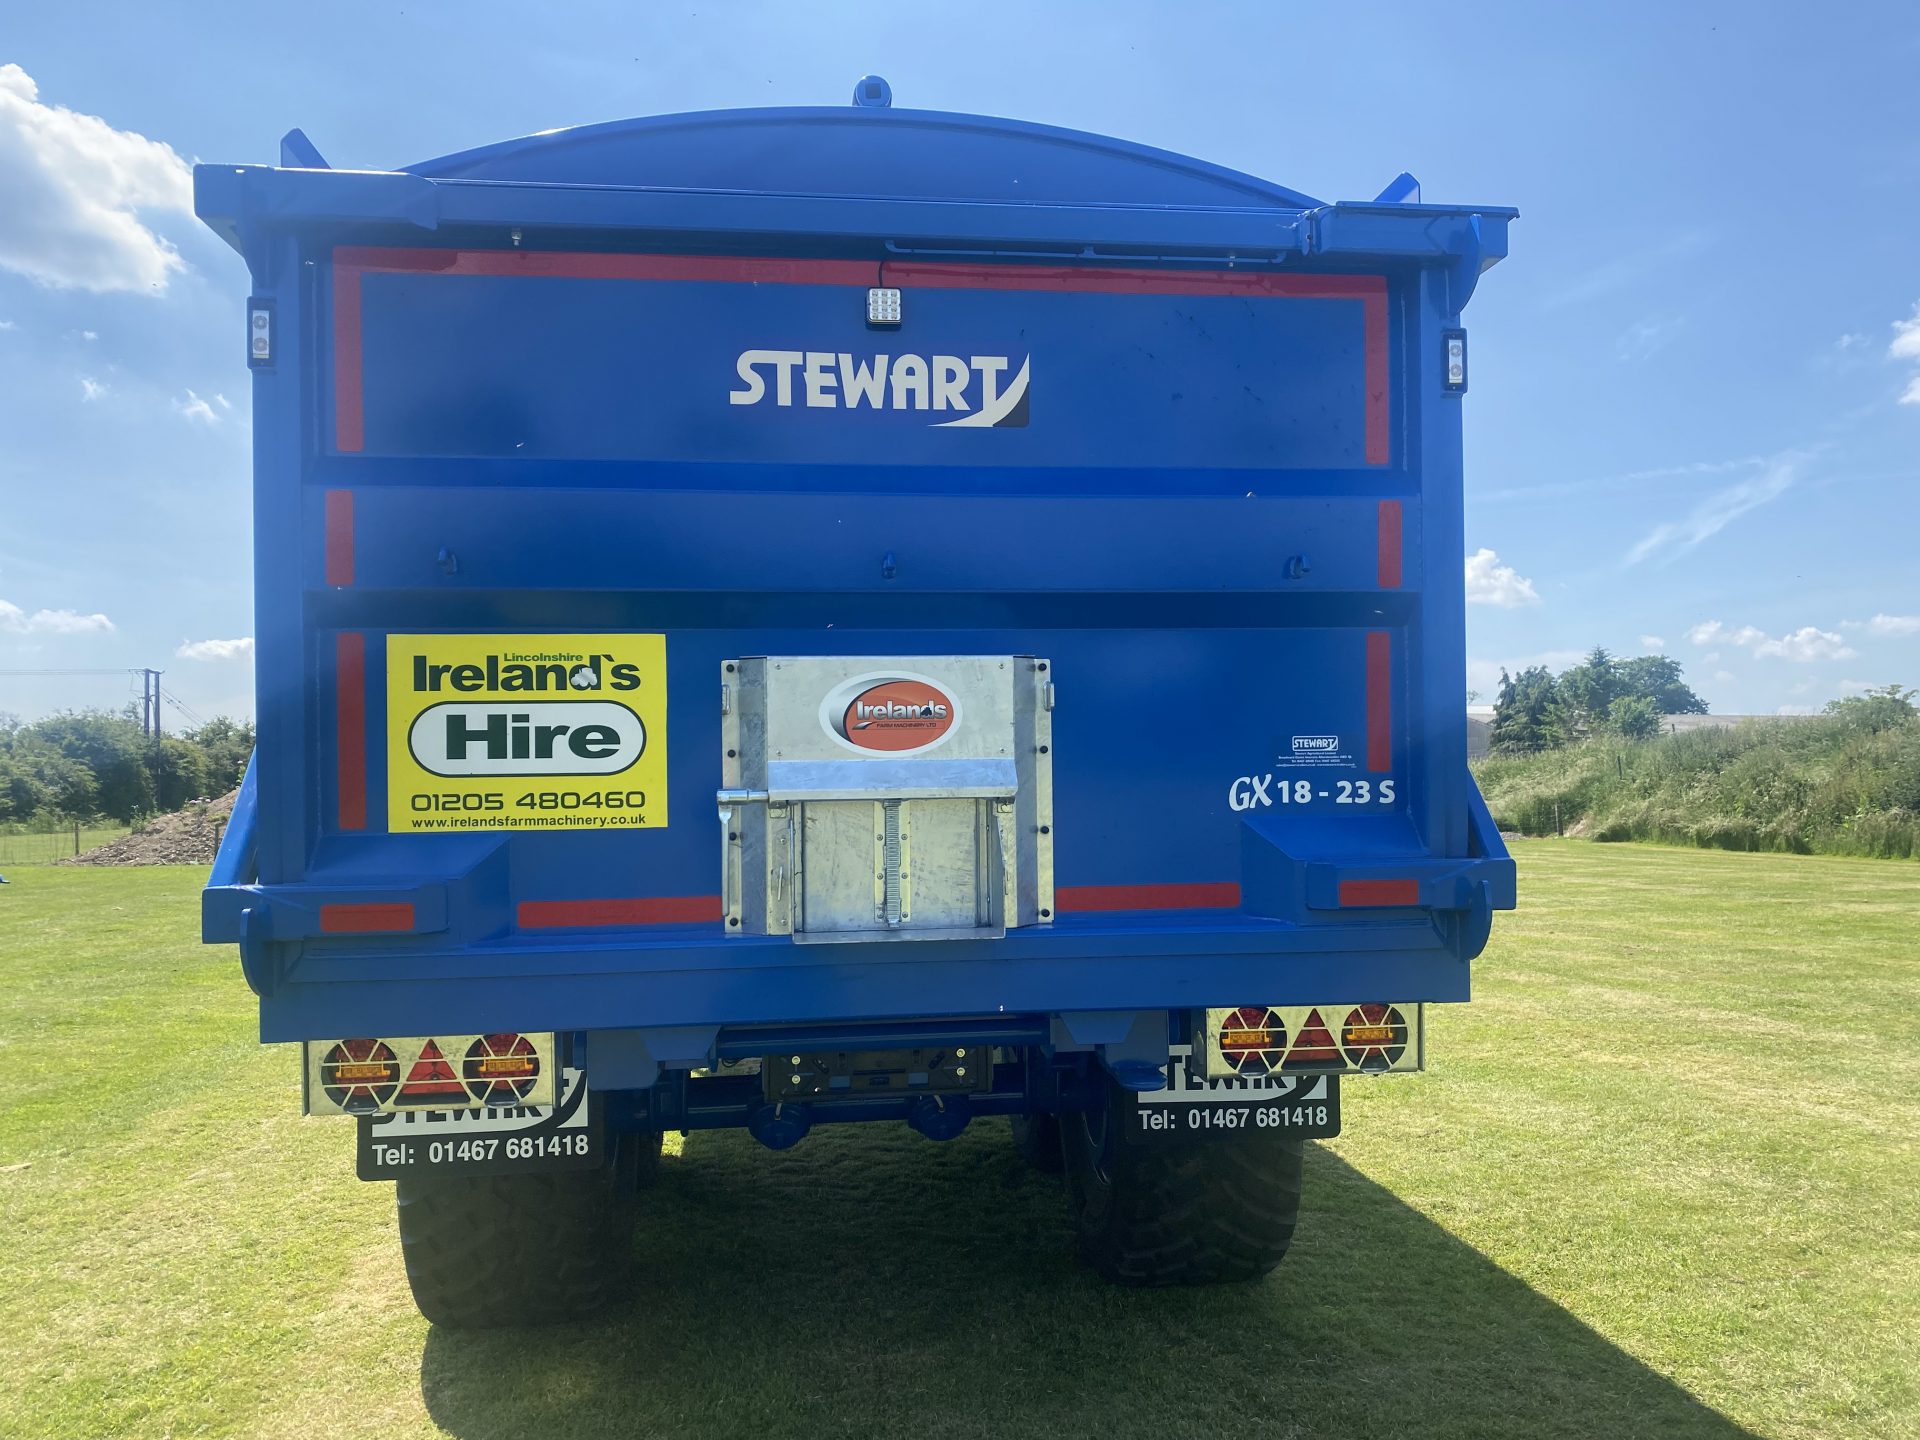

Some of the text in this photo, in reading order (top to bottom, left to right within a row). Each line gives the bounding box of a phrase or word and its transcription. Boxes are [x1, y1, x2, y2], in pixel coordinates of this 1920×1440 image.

[730, 349, 1030, 427] STEWART
[503, 653, 583, 662] Lincolnshire
[856, 700, 947, 720] Irelands
[446, 713, 621, 760] Hire
[1293, 738, 1337, 750] STEWART
[411, 791, 646, 811] 01205 480460
[1379, 780, 1395, 803] S
[411, 814, 646, 828] www.irelandsfarmmachinery.co.uk
[1138, 1106, 1328, 1130] Tel: 01467 681418
[372, 1134, 589, 1166] Tel: 01467 681418
